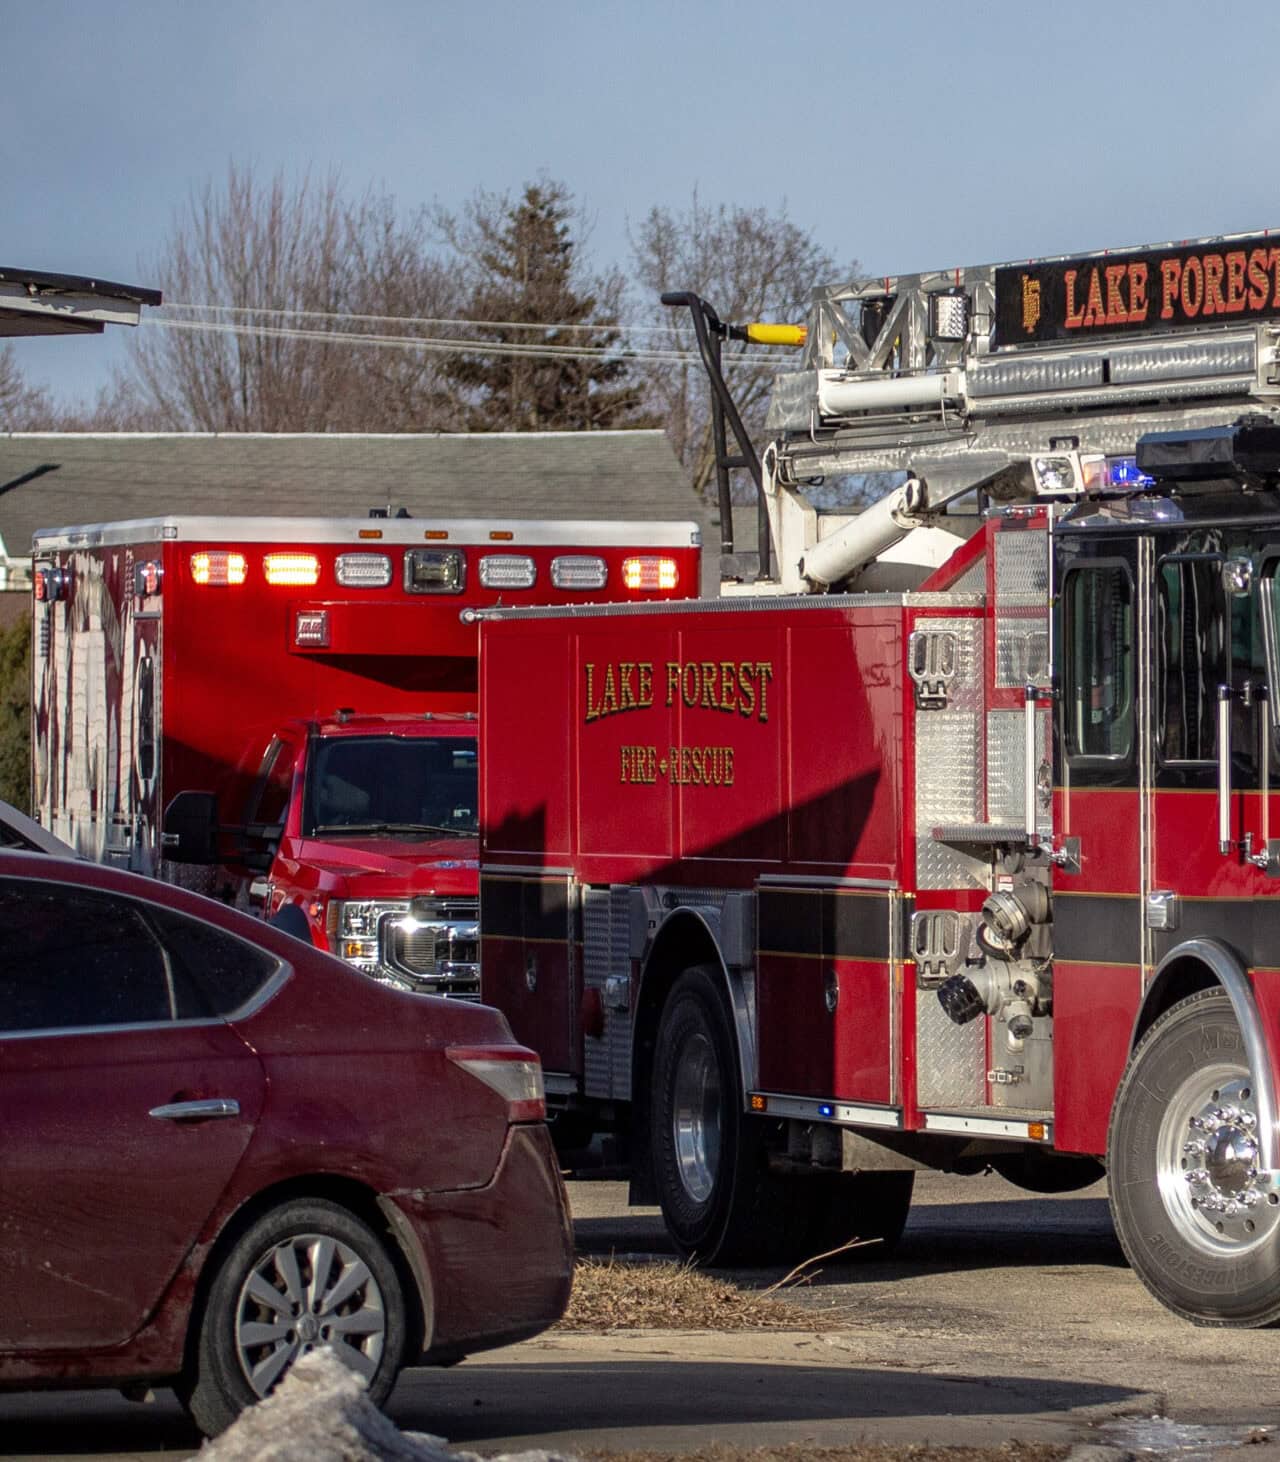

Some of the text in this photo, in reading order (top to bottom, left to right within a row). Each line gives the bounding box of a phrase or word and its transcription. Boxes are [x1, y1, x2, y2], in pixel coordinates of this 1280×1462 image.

[1064, 262, 1149, 328] LAKE
[584, 662, 773, 723] LAKE FOREST
[620, 746, 735, 786] FIRE RESCUE
